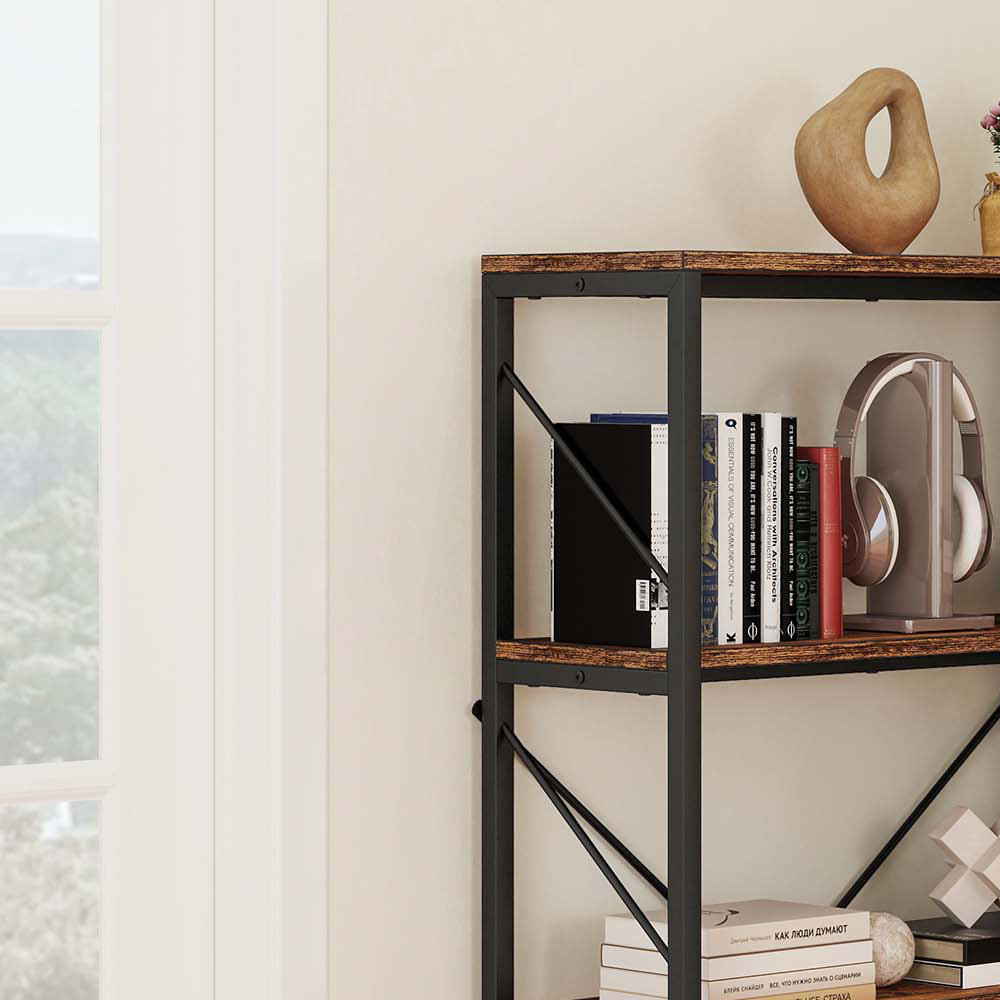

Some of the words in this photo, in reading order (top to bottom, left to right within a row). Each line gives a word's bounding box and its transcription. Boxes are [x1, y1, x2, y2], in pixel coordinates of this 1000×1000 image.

[774, 932, 790, 940] КАК
[790, 928, 814, 939] ЛЮДИ
[815, 924, 848, 937] ДУМАЮТ
